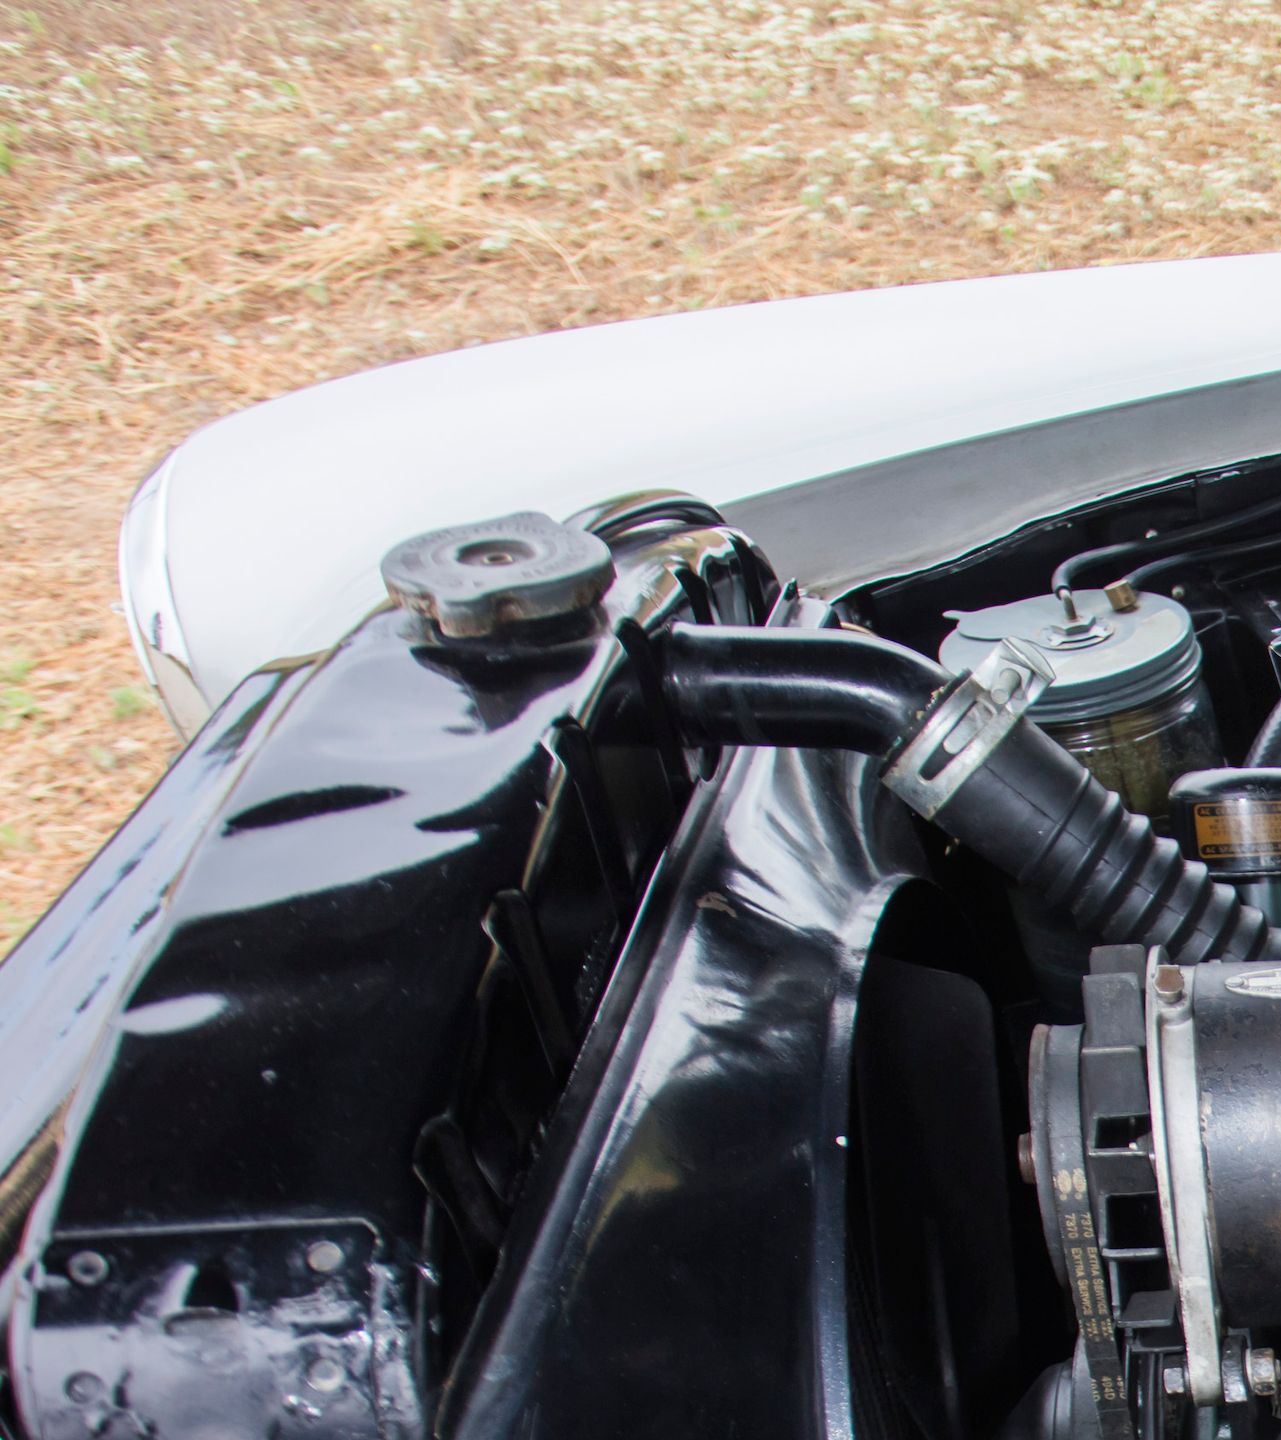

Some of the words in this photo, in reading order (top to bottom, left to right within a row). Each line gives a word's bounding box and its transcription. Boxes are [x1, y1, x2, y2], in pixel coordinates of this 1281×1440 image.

[1065, 1213, 1078, 1239] 7370
[1080, 1211, 1094, 1238] 7370
[1071, 1248, 1085, 1277] EXTRA
[1087, 1247, 1100, 1276] EXTRA
[1077, 1279, 1093, 1316] SERVICE
[1093, 1278, 1107, 1315] SERVICE
